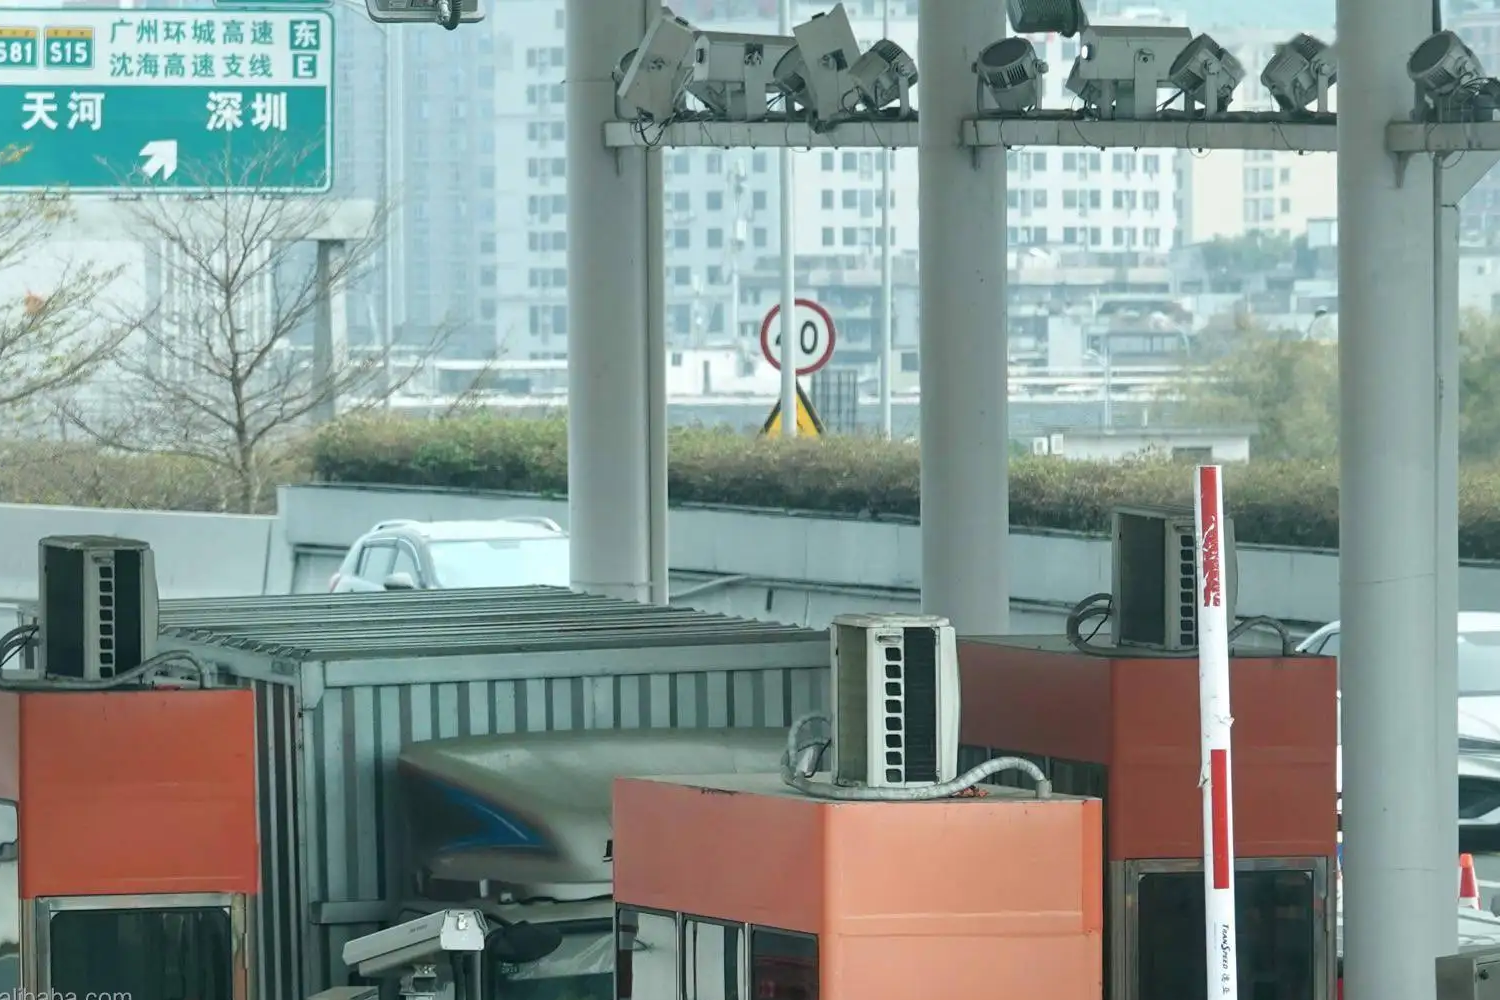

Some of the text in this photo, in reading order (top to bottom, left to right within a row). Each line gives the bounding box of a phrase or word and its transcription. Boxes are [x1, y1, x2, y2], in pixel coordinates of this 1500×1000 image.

[109, 19, 274, 45] 广州环城高速
[292, 21, 318, 48] 东
[49, 40, 88, 64] S15
[109, 53, 274, 78] 沈海高速支线
[296, 56, 313, 76] E
[21, 91, 106, 132] 天河
[205, 91, 289, 132] 深圳
[775, 321, 819, 356] 0
